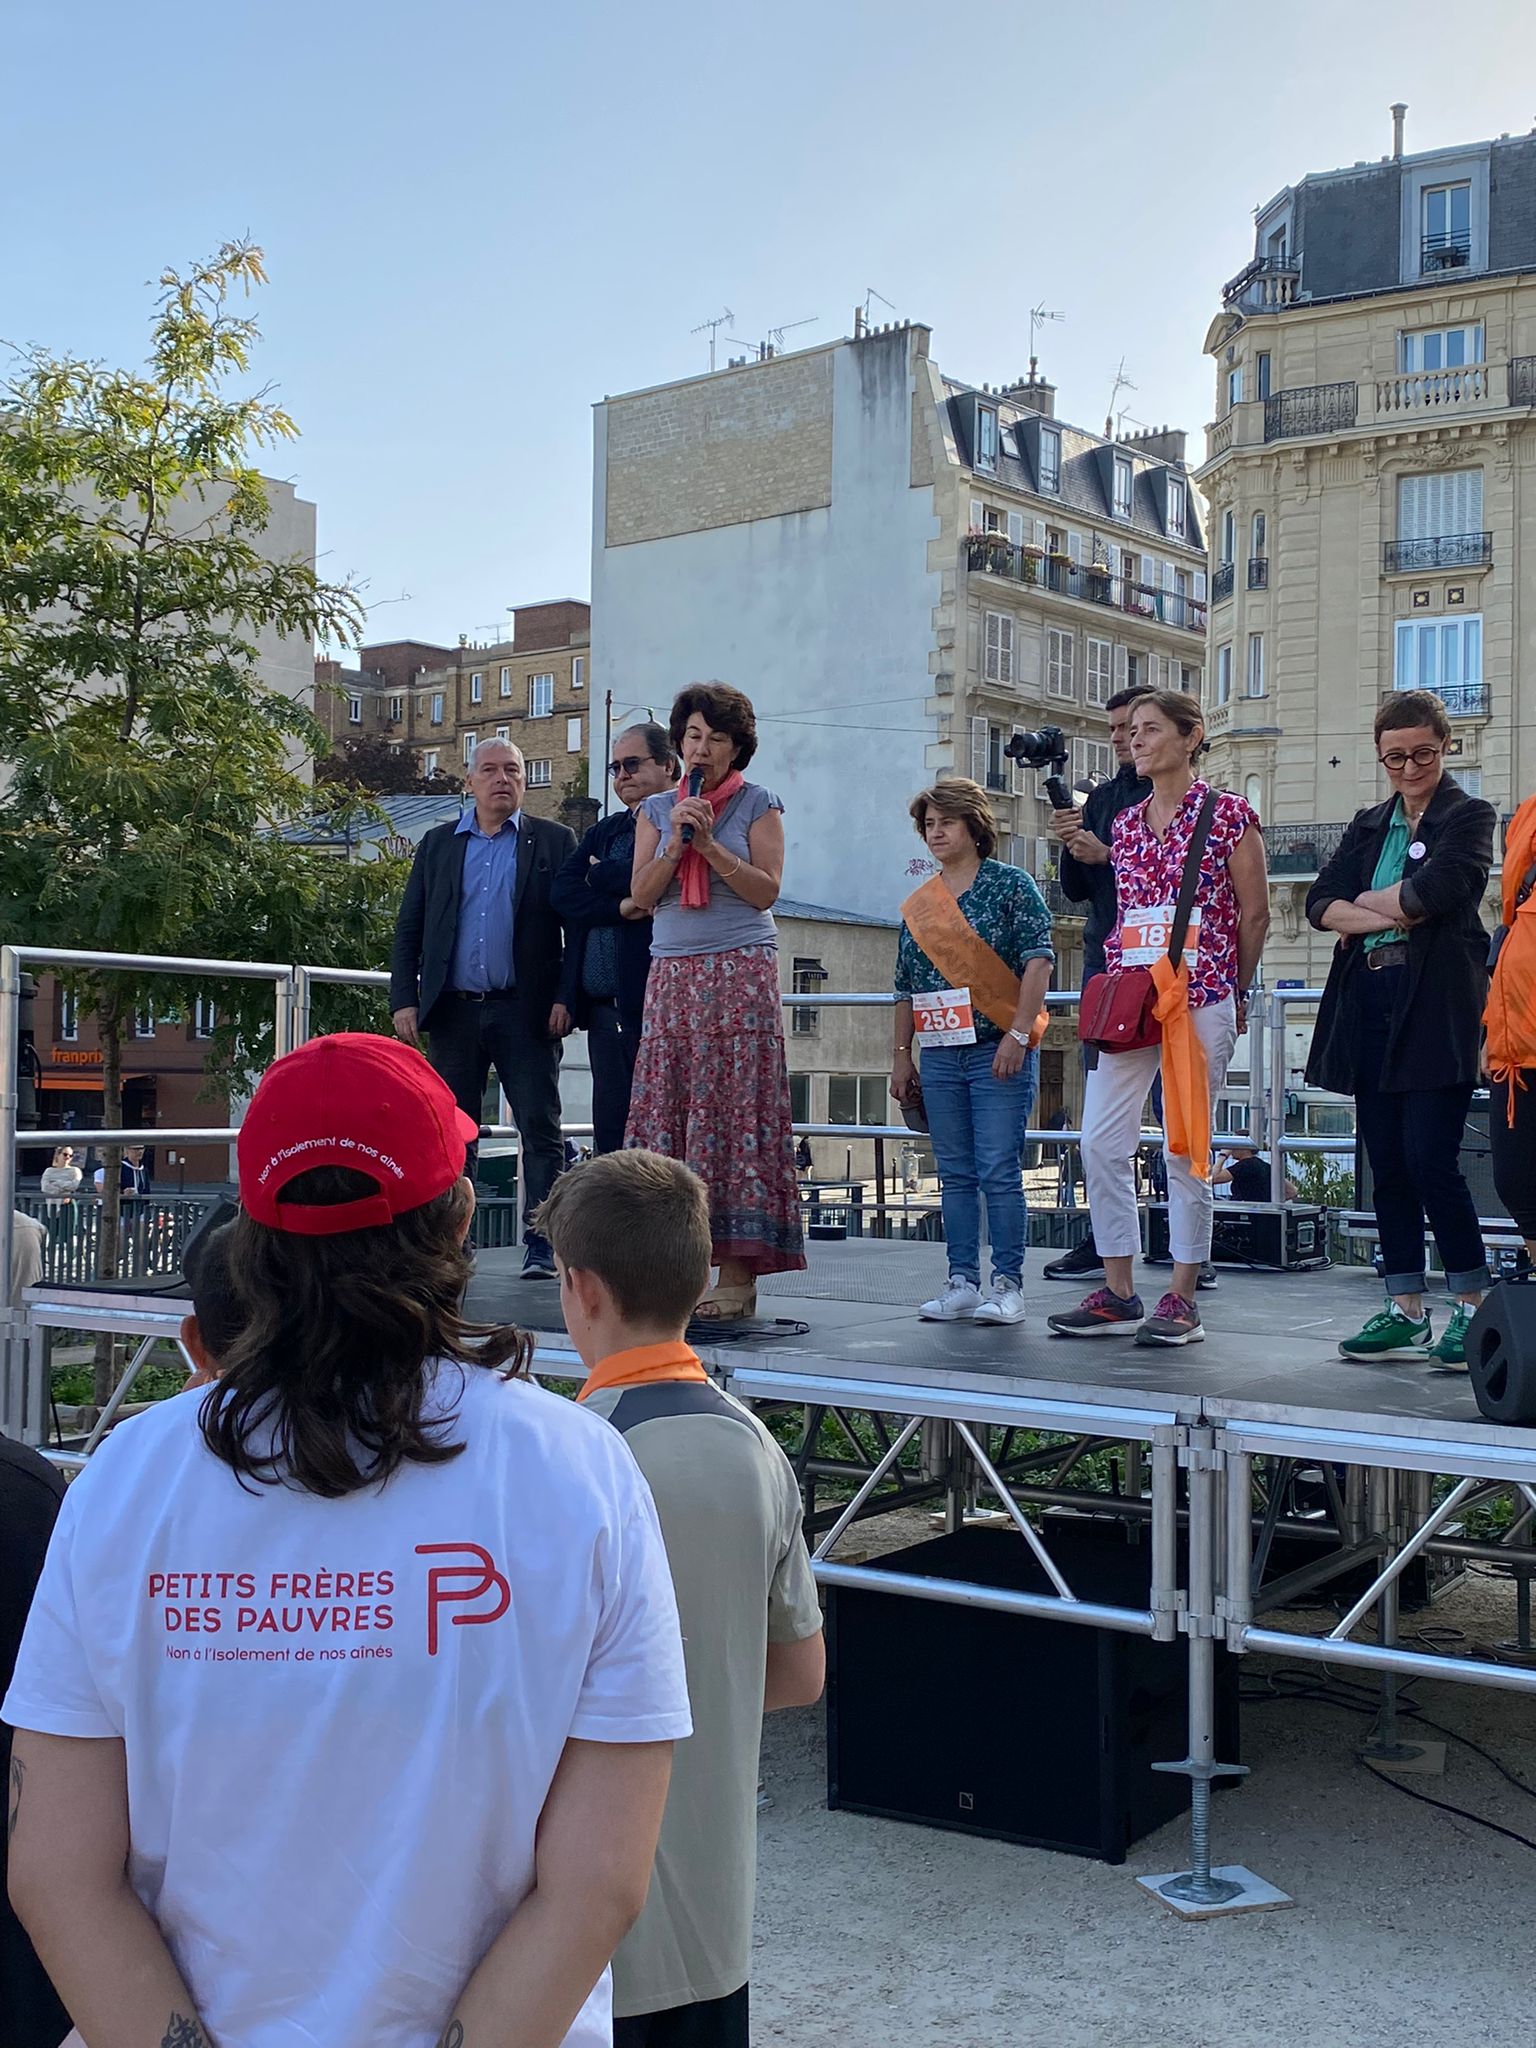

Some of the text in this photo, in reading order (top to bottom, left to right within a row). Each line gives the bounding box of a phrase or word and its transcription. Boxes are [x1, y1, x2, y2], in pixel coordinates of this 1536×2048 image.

[921, 1007, 961, 1031] 256
[257, 1163, 272, 1185] Non
[339, 1137, 356, 1148] de
[357, 1143, 378, 1158] nos
[149, 1567, 394, 1599] PETITS FRÈRES
[165, 1604, 394, 1633] DES PAUVRES
[166, 1645, 191, 1660] Non
[193, 1647, 201, 1660] à
[295, 1648, 315, 1661] de
[320, 1649, 346, 1660] nos
[350, 1645, 393, 1659] aînés
